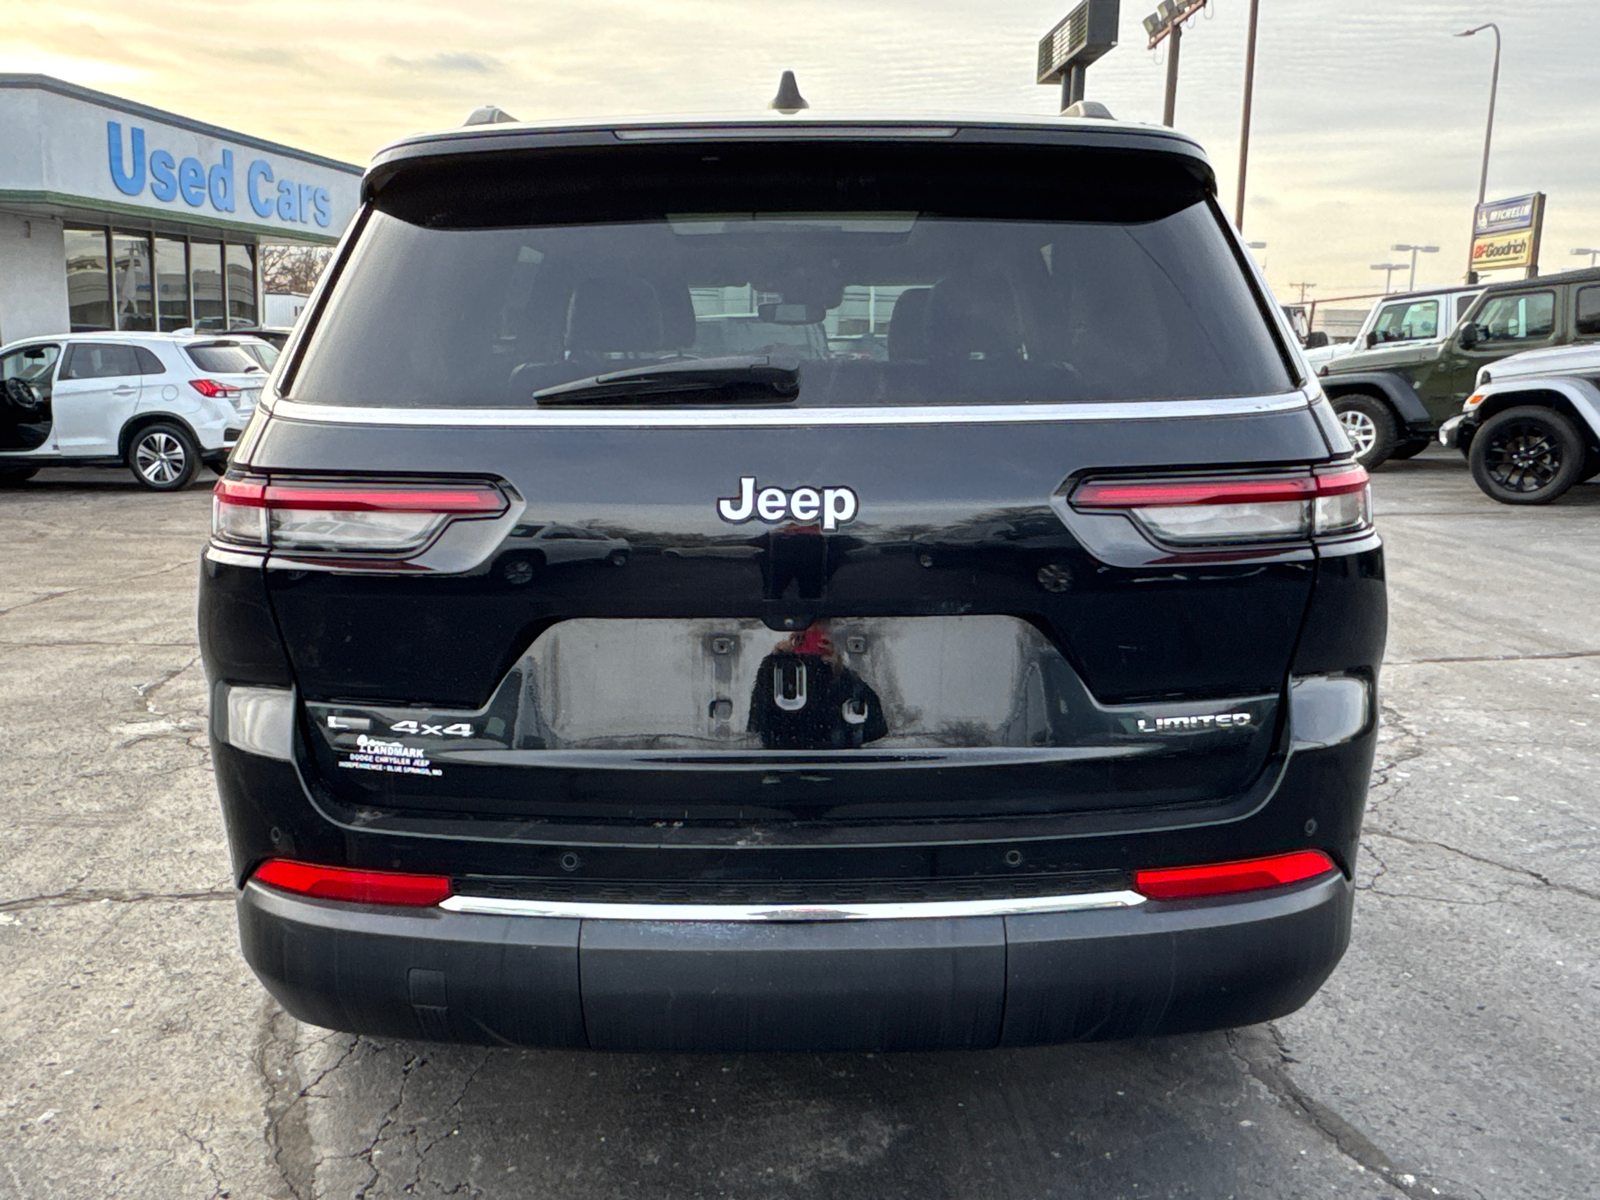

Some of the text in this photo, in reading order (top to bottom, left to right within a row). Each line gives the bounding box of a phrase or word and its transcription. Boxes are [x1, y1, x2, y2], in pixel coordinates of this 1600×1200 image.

[107, 121, 331, 227] Used Cars
[1489, 204, 1531, 222] MICHELIN
[1473, 239, 1526, 259] BFGoodrich
[718, 476, 857, 530] Jeep
[390, 720, 474, 737] 4x4
[1137, 713, 1251, 733] LIMITED
[350, 753, 430, 767] DODGE CHRYSLER JEEP
[367, 745, 425, 758] LANDMARK
